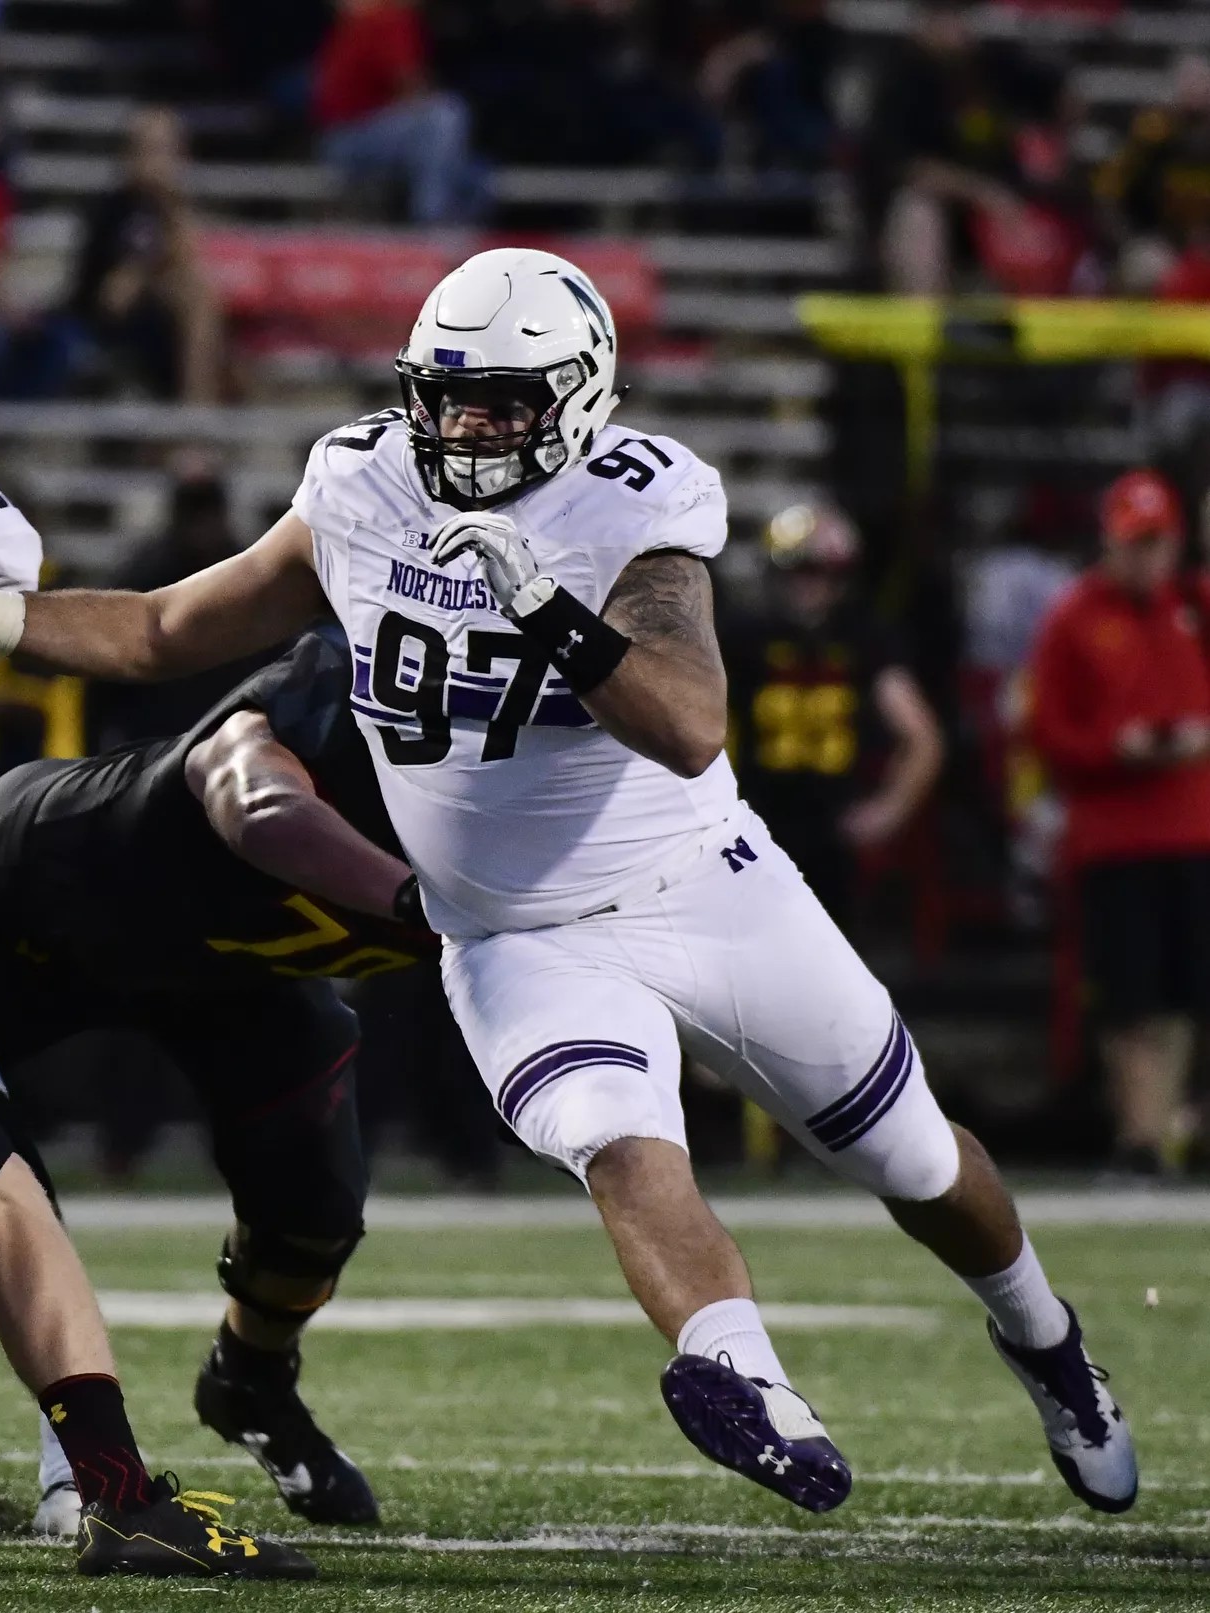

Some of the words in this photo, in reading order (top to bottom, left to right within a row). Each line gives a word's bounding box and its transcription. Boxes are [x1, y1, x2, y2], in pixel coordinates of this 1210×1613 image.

[586, 438, 674, 493] 97
[372, 610, 549, 766] 97
[720, 834, 759, 874] N
